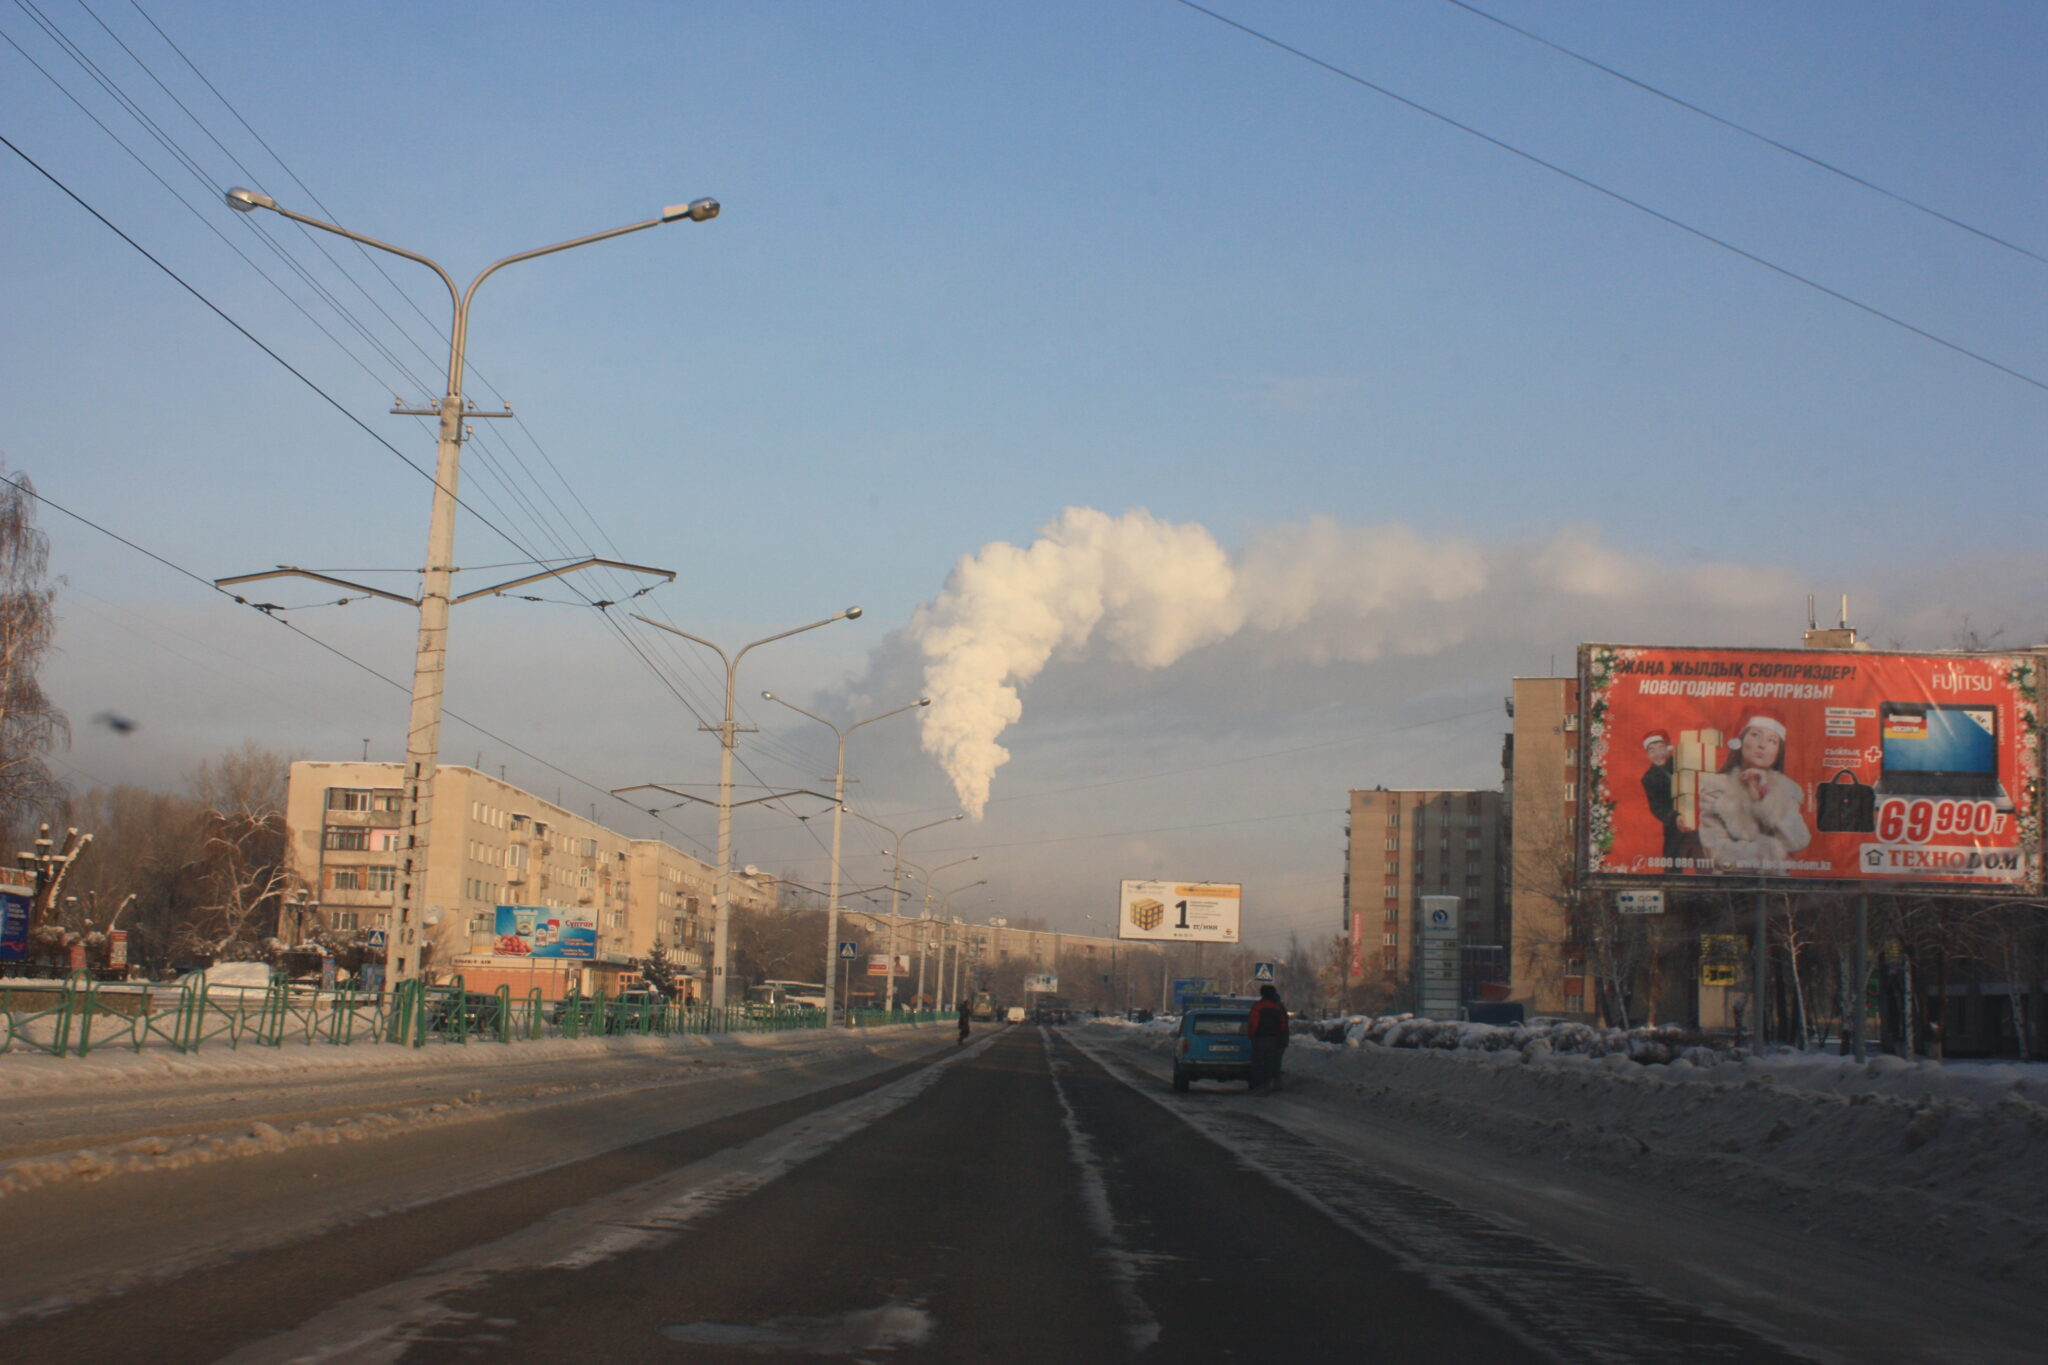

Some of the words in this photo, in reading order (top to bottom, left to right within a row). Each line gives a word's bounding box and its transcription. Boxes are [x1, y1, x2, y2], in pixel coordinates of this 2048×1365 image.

[1748, 663, 1857, 681] СЮРПРИЗДЕР!
[1639, 680, 1736, 698] НОВОГОДНИЕ
[1738, 682, 1835, 699] СЮРПРИЗЫ!
[1932, 674, 1993, 695] FUJITSU
[1175, 900, 1190, 929] 1
